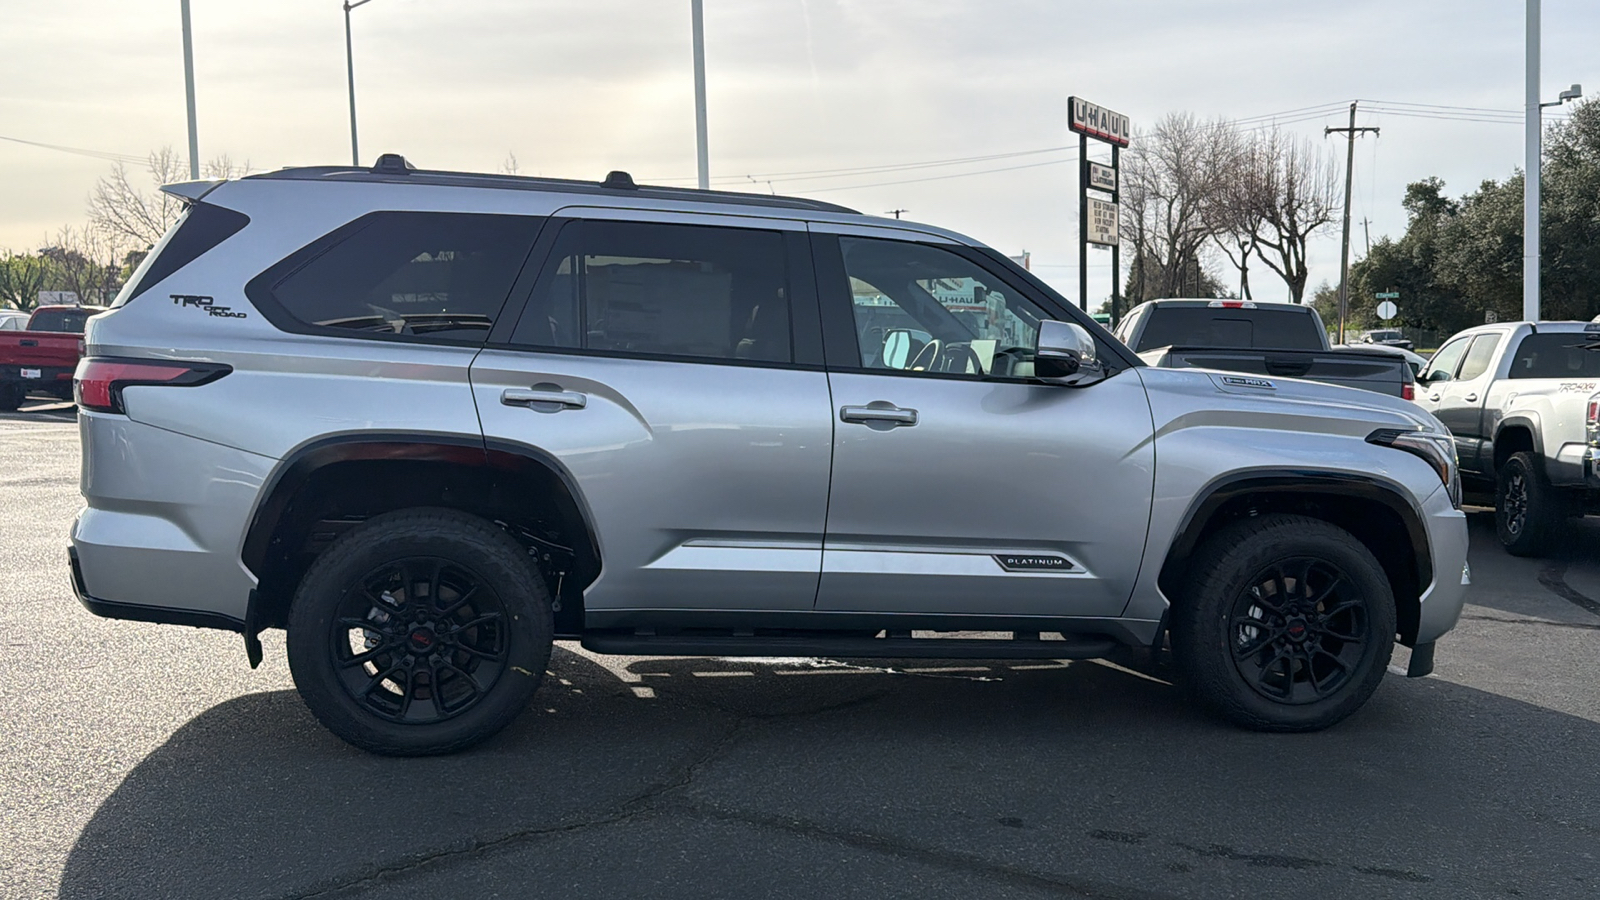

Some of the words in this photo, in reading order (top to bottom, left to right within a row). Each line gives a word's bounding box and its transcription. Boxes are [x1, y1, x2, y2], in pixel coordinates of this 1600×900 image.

[169, 294, 214, 308] TRD
[209, 311, 247, 319] ROAD
[1007, 558, 1063, 566] PLATINUM
